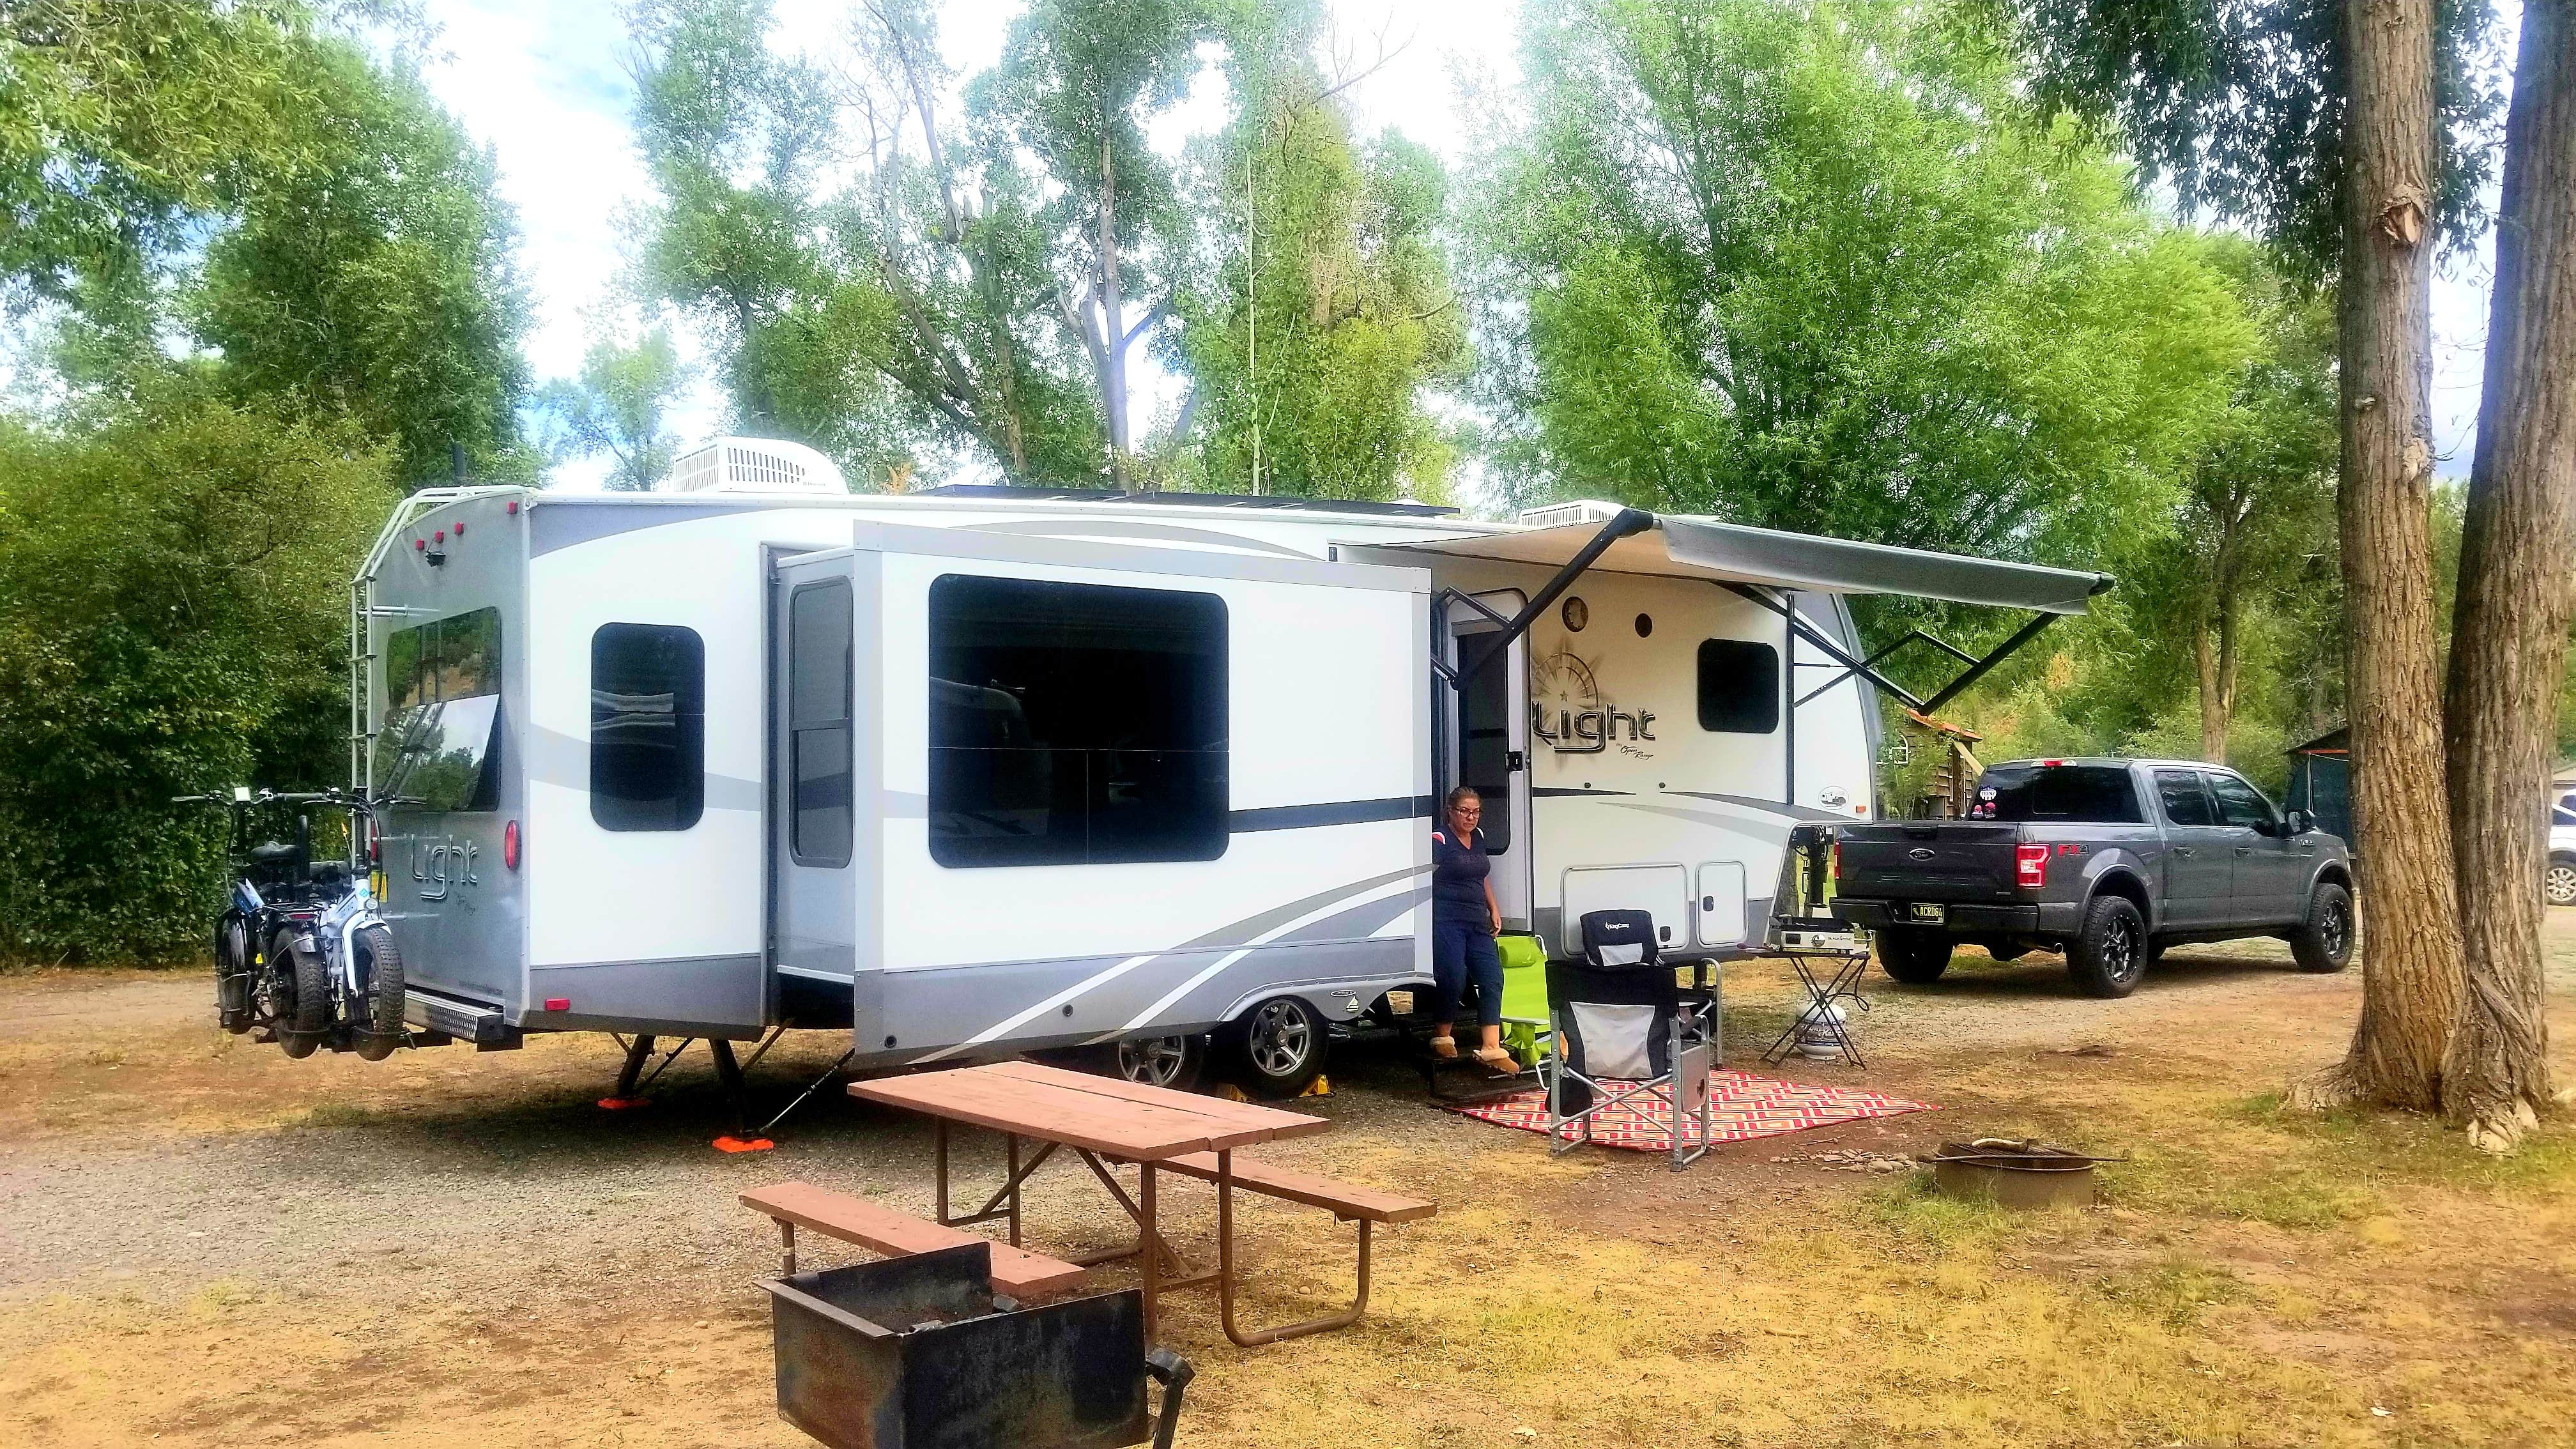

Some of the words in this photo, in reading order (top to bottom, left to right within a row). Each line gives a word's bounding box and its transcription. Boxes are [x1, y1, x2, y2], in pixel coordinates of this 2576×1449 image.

[1532, 701, 1655, 753] Light
[411, 834, 477, 900] Light
[2058, 844, 2089, 856] FX4
